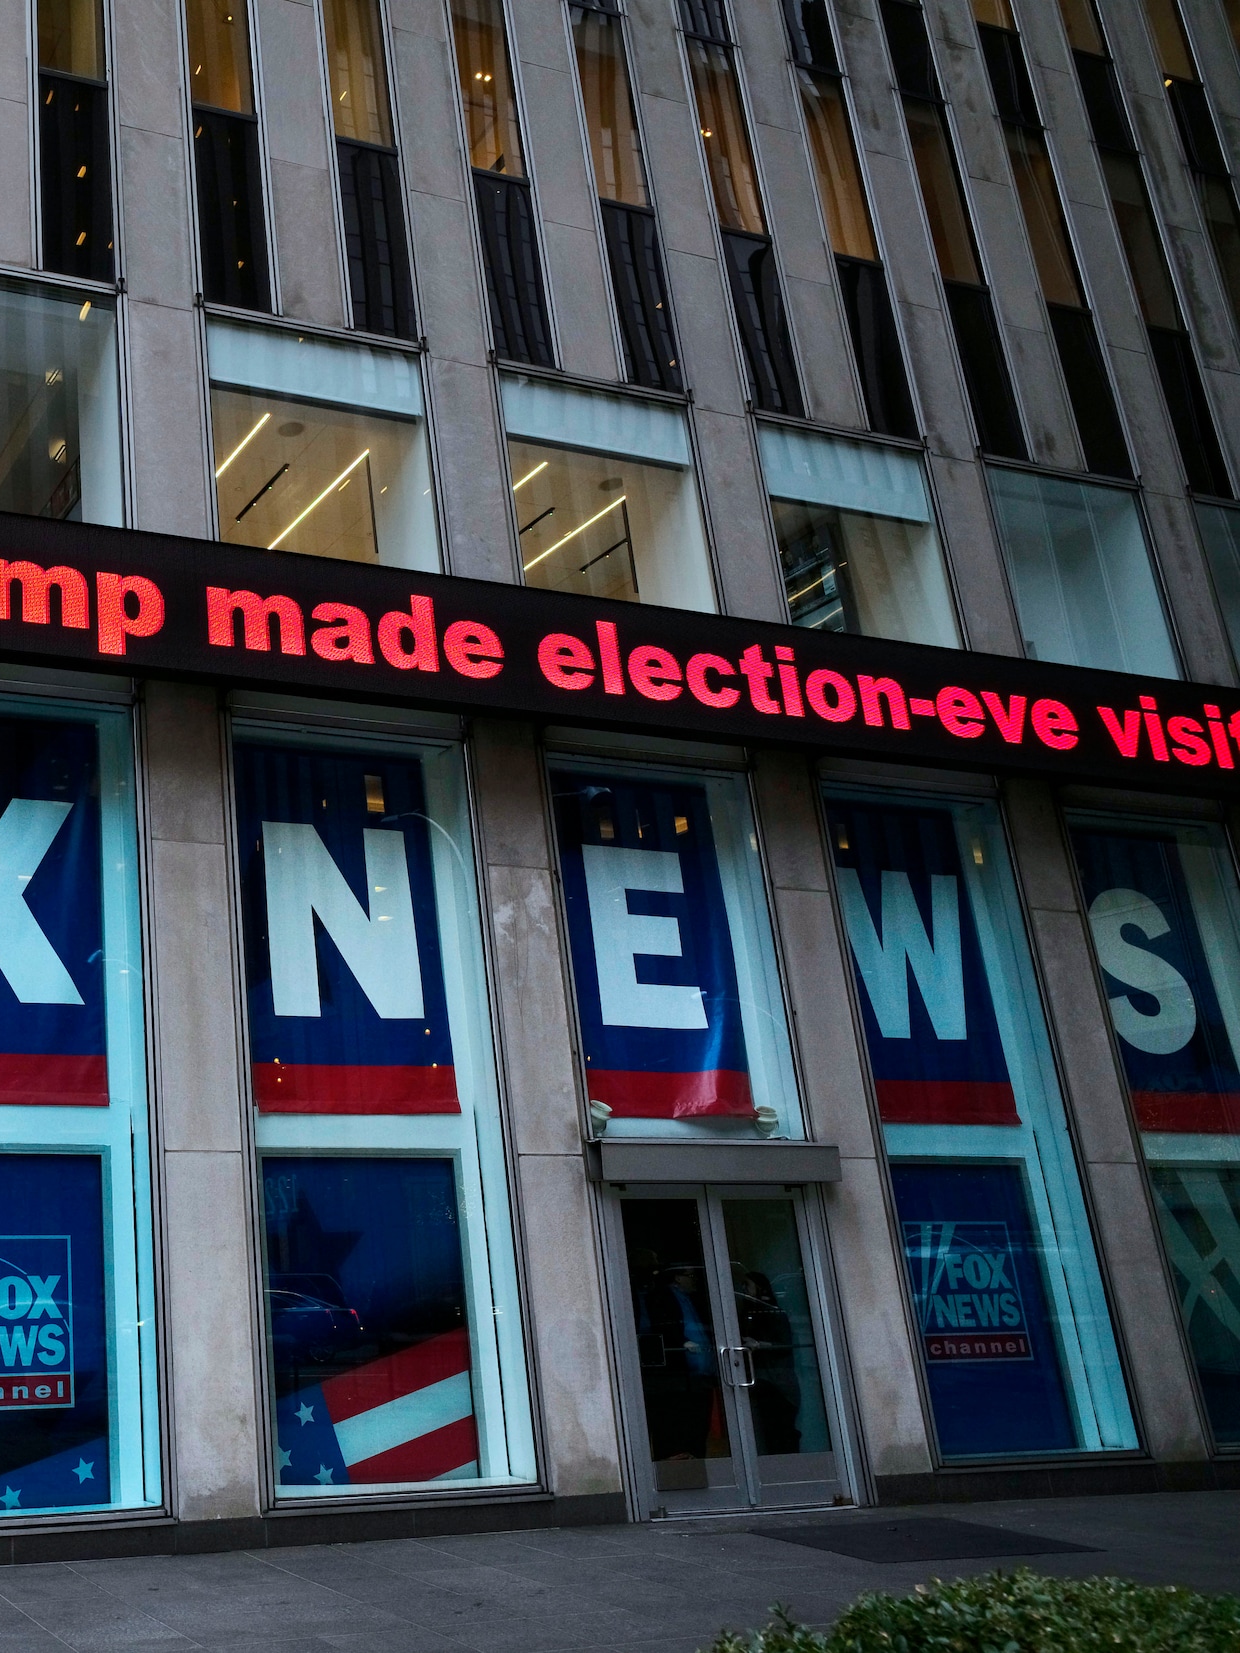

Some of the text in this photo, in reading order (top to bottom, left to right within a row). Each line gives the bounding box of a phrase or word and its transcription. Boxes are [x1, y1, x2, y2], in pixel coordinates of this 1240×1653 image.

[207, 587, 504, 678] made
[538, 621, 1078, 749] election-eve
[944, 1253, 1013, 1289] FOX
[933, 1293, 1020, 1328] NEWS
[930, 1339, 1026, 1355] channel
